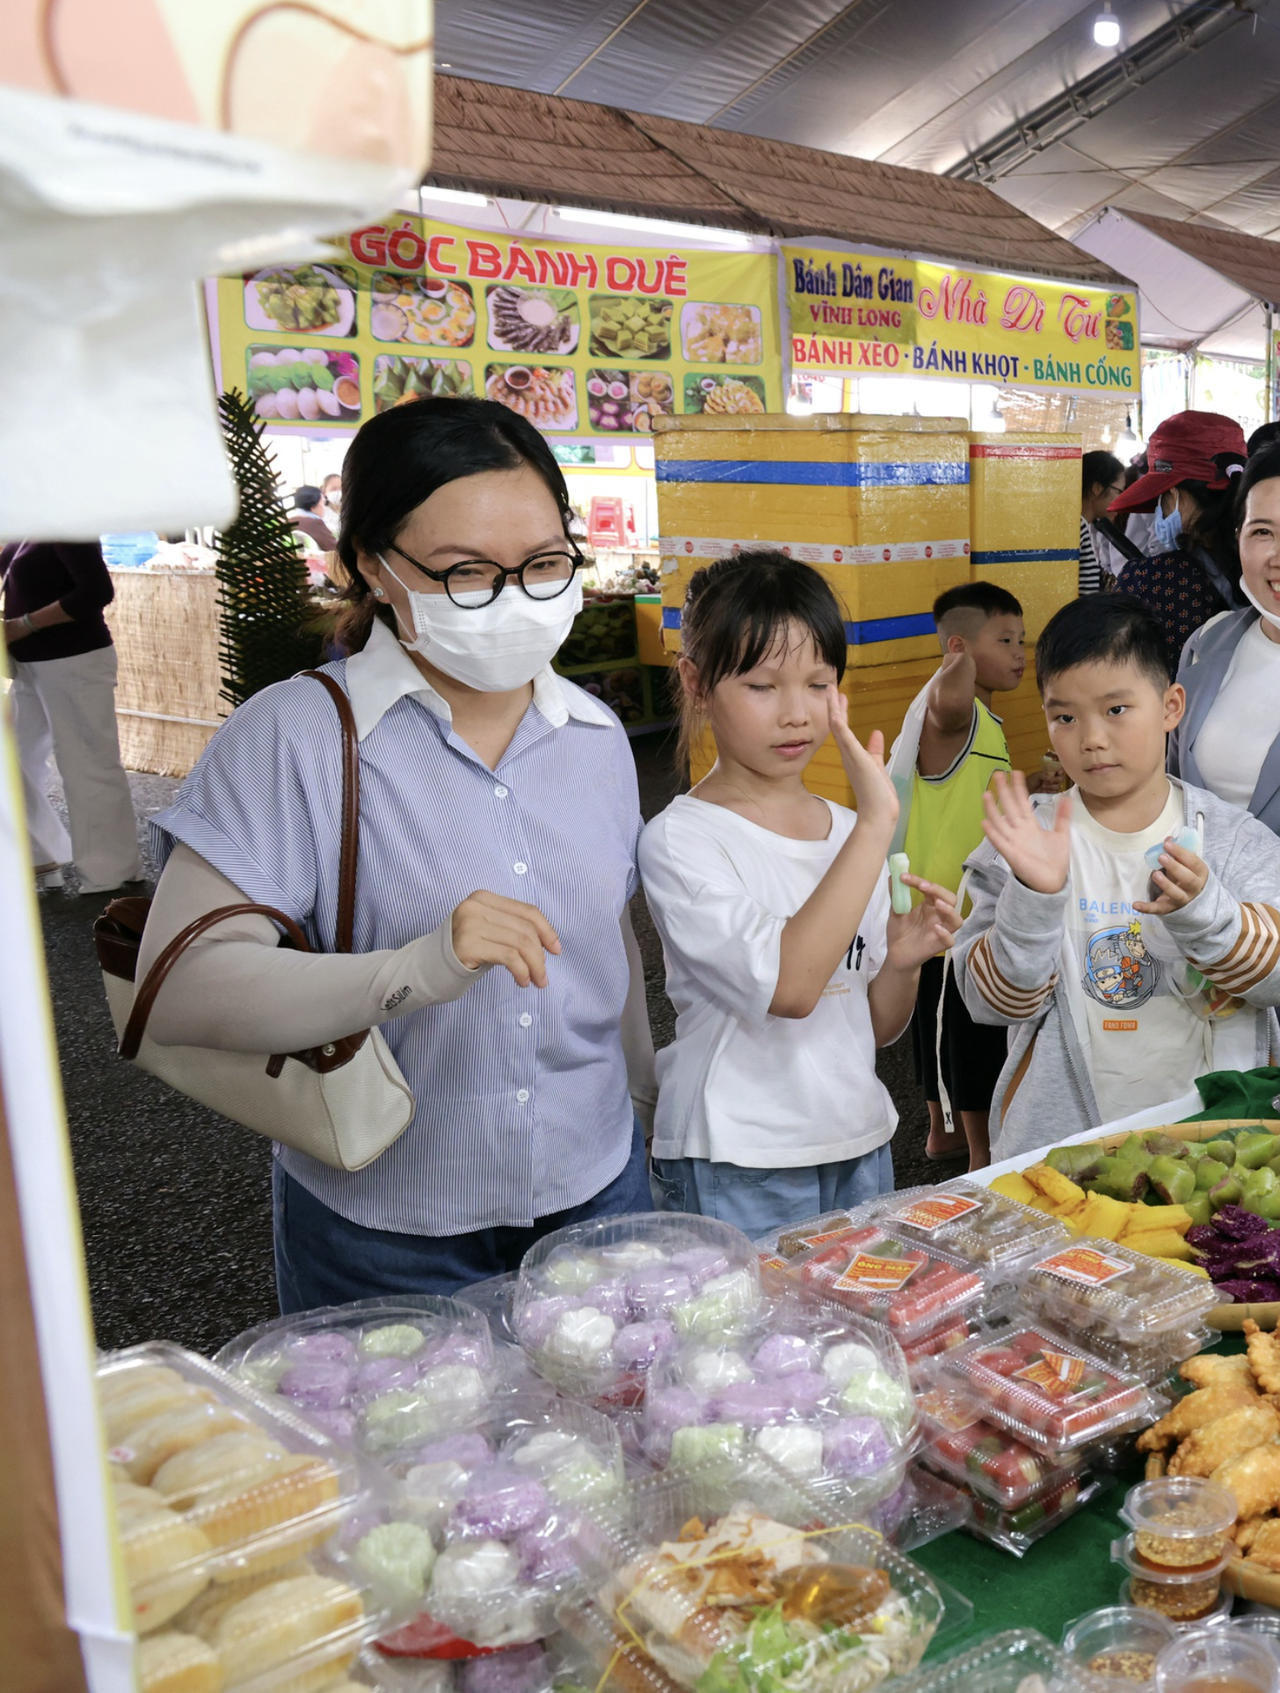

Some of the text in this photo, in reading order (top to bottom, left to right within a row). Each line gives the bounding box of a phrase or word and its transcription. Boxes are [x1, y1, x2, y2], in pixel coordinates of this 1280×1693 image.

[350, 222, 688, 297] GÓC BÁNH QUÊ
[793, 257, 914, 303] Bánh Dân Gian
[809, 300, 902, 329] VĨNH LONG
[918, 272, 1104, 344] Nhà Dì Tư
[792, 332, 1133, 388] BÁNH XÈO BÁNH KHỌT BÁNH CỐNG
